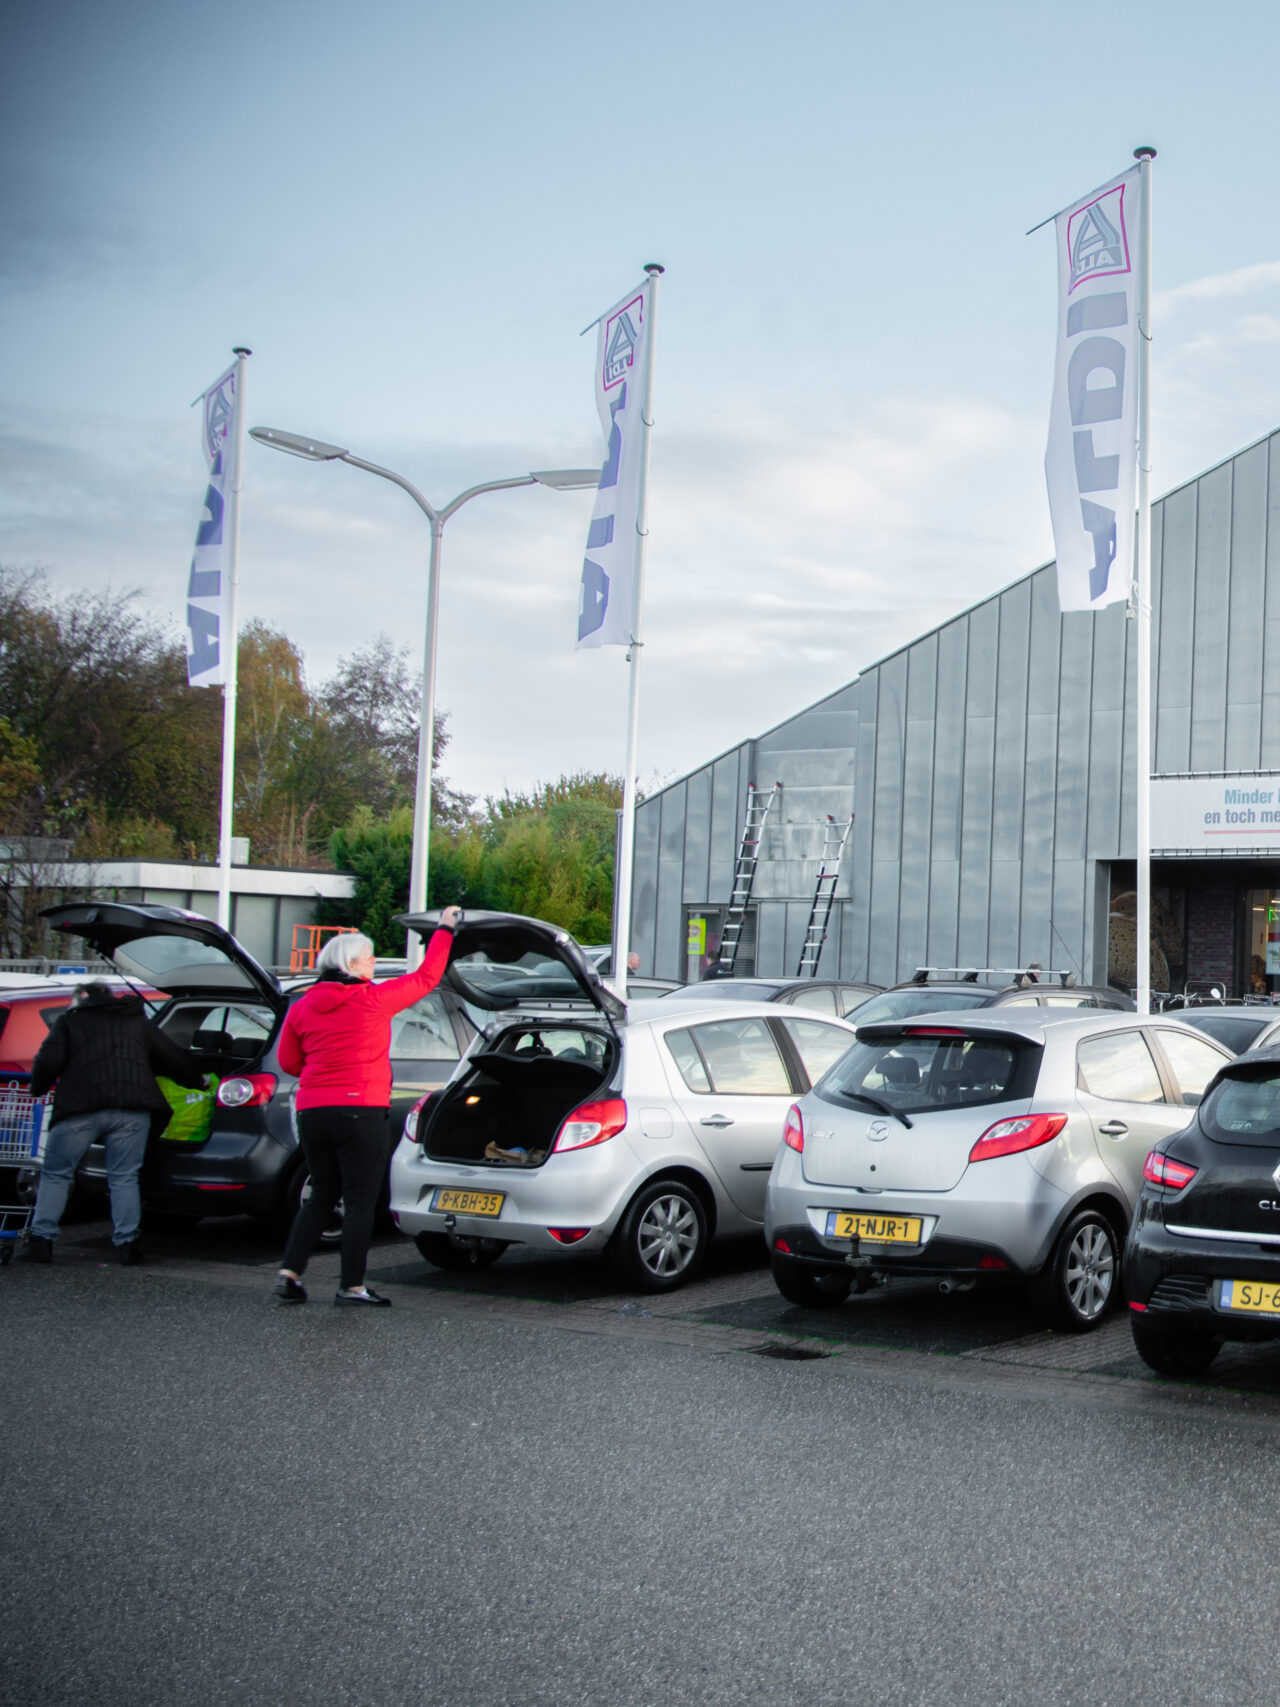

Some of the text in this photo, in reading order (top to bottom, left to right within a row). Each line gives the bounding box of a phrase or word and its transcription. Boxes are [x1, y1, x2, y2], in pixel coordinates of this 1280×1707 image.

[1224, 788, 1273, 804] Minder
[1204, 812, 1220, 824] en
[1225, 808, 1255, 823] toch
[441, 1192, 498, 1211] 9-KBH-35
[844, 1217, 909, 1238] 21-NJR-1
